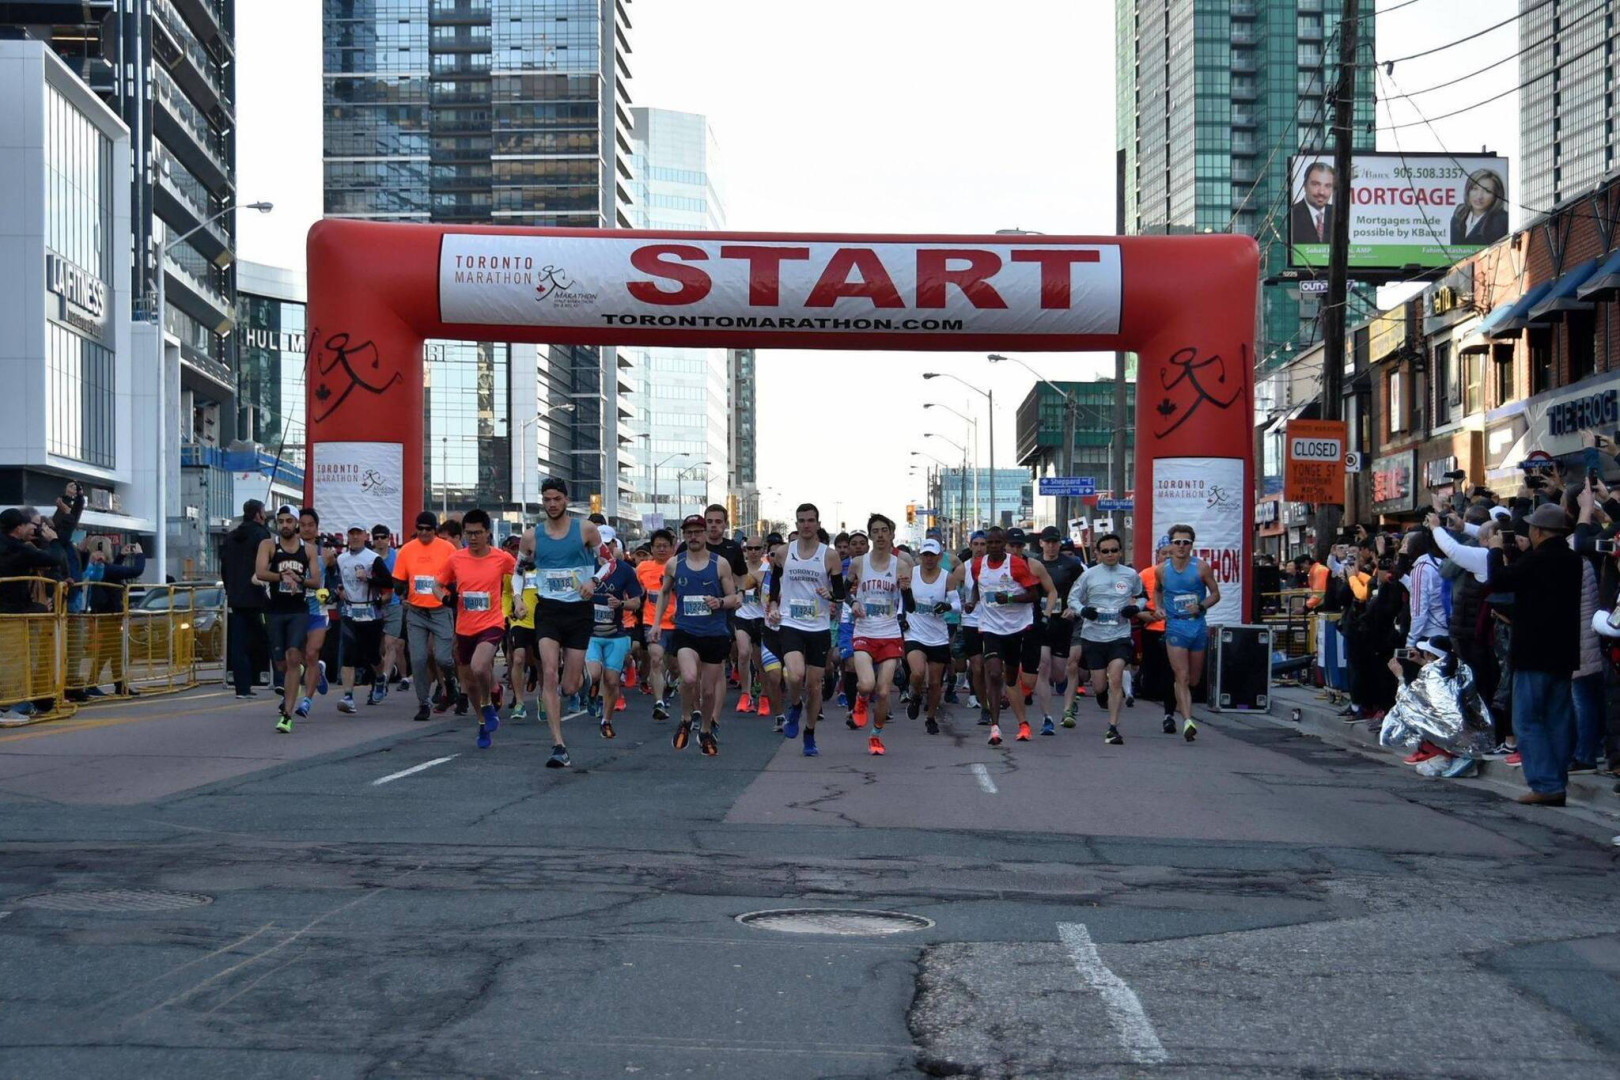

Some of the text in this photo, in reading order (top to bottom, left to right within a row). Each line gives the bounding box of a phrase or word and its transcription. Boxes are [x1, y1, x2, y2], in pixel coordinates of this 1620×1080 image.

[1349, 187, 1456, 206] ORTGAGE
[1356, 215, 1441, 227] Mortgages made
[1353, 228, 1395, 239] possible
[1396, 228, 1409, 239] by
[455, 255, 533, 270] TORONTO
[454, 270, 533, 285] MARATHON
[626, 243, 1101, 310] START
[66, 263, 104, 317] FITNESS
[601, 313, 964, 331] TORONTOMARATHON.COM
[1547, 390, 1618, 436] THE FROG
[1294, 441, 1337, 457] CLOSED
[317, 464, 359, 473] TORONTO
[1292, 463, 1321, 477] YONGE
[316, 474, 359, 482] MARATHON
[1158, 480, 1205, 489] TORONTO
[1157, 490, 1205, 498] MARATHON
[789, 569, 820, 577] TORONTO
